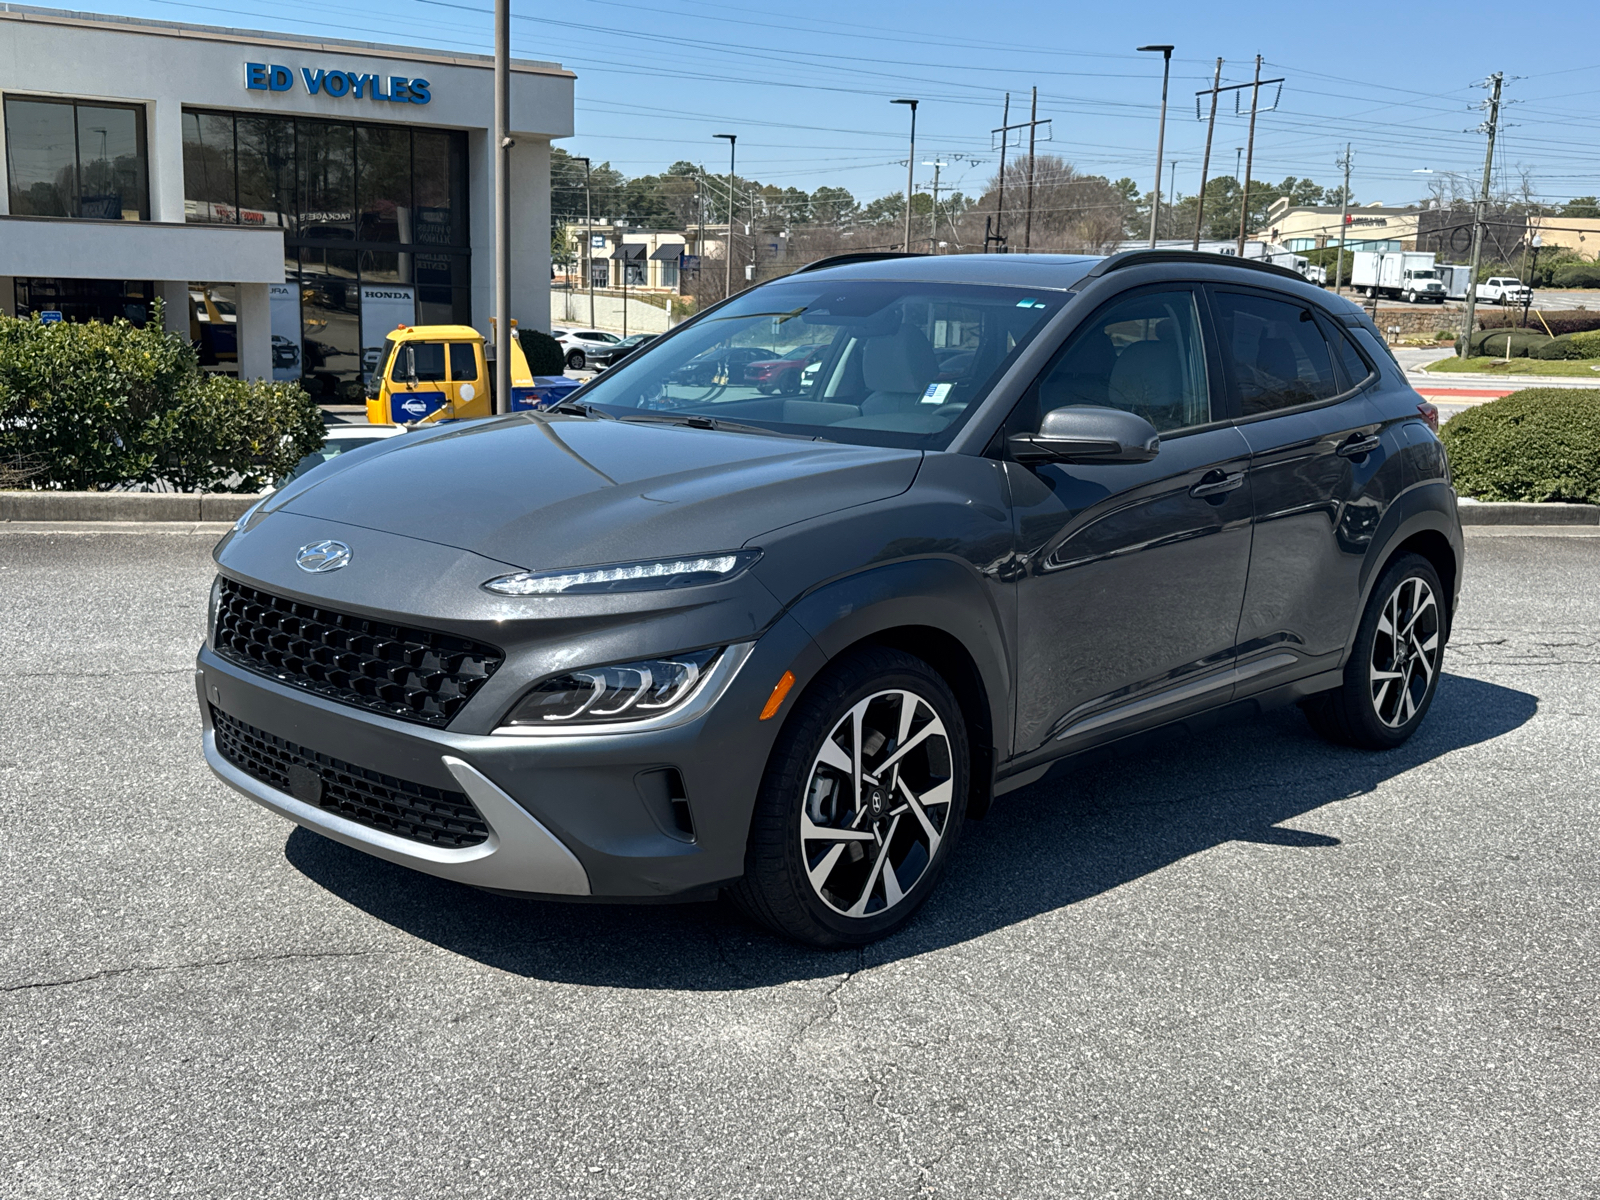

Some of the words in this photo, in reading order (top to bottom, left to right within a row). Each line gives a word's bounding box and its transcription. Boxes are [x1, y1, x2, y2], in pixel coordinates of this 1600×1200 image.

[244, 62, 294, 92] ED
[299, 67, 431, 105] VOYLES
[364, 291, 412, 300] HONDA
